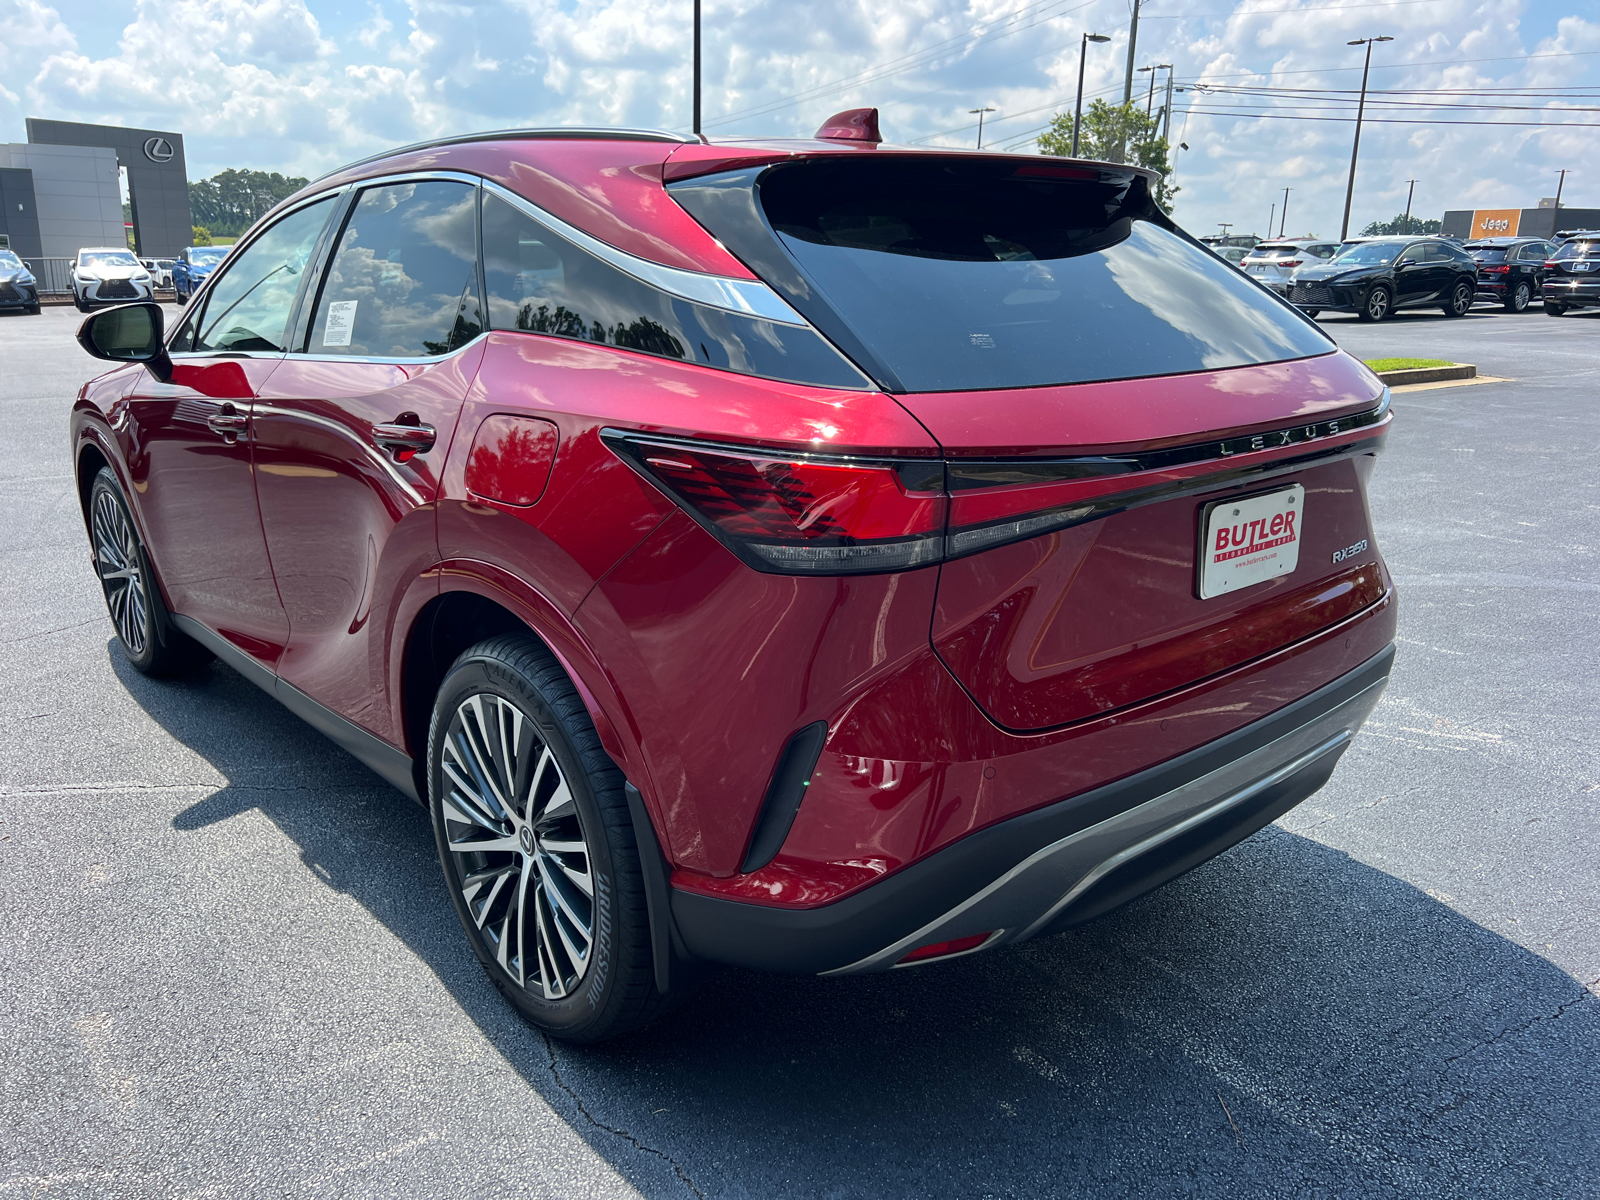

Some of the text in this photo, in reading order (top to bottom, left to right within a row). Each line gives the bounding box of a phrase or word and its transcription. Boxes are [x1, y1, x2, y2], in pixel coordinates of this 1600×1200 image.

[1480, 217, 1509, 232] Jeep
[1220, 421, 1340, 456] LEXUS
[1332, 539, 1368, 564] RX350
[492, 665, 543, 716] ALENZA
[586, 870, 612, 1011] BRIDGESTONE
